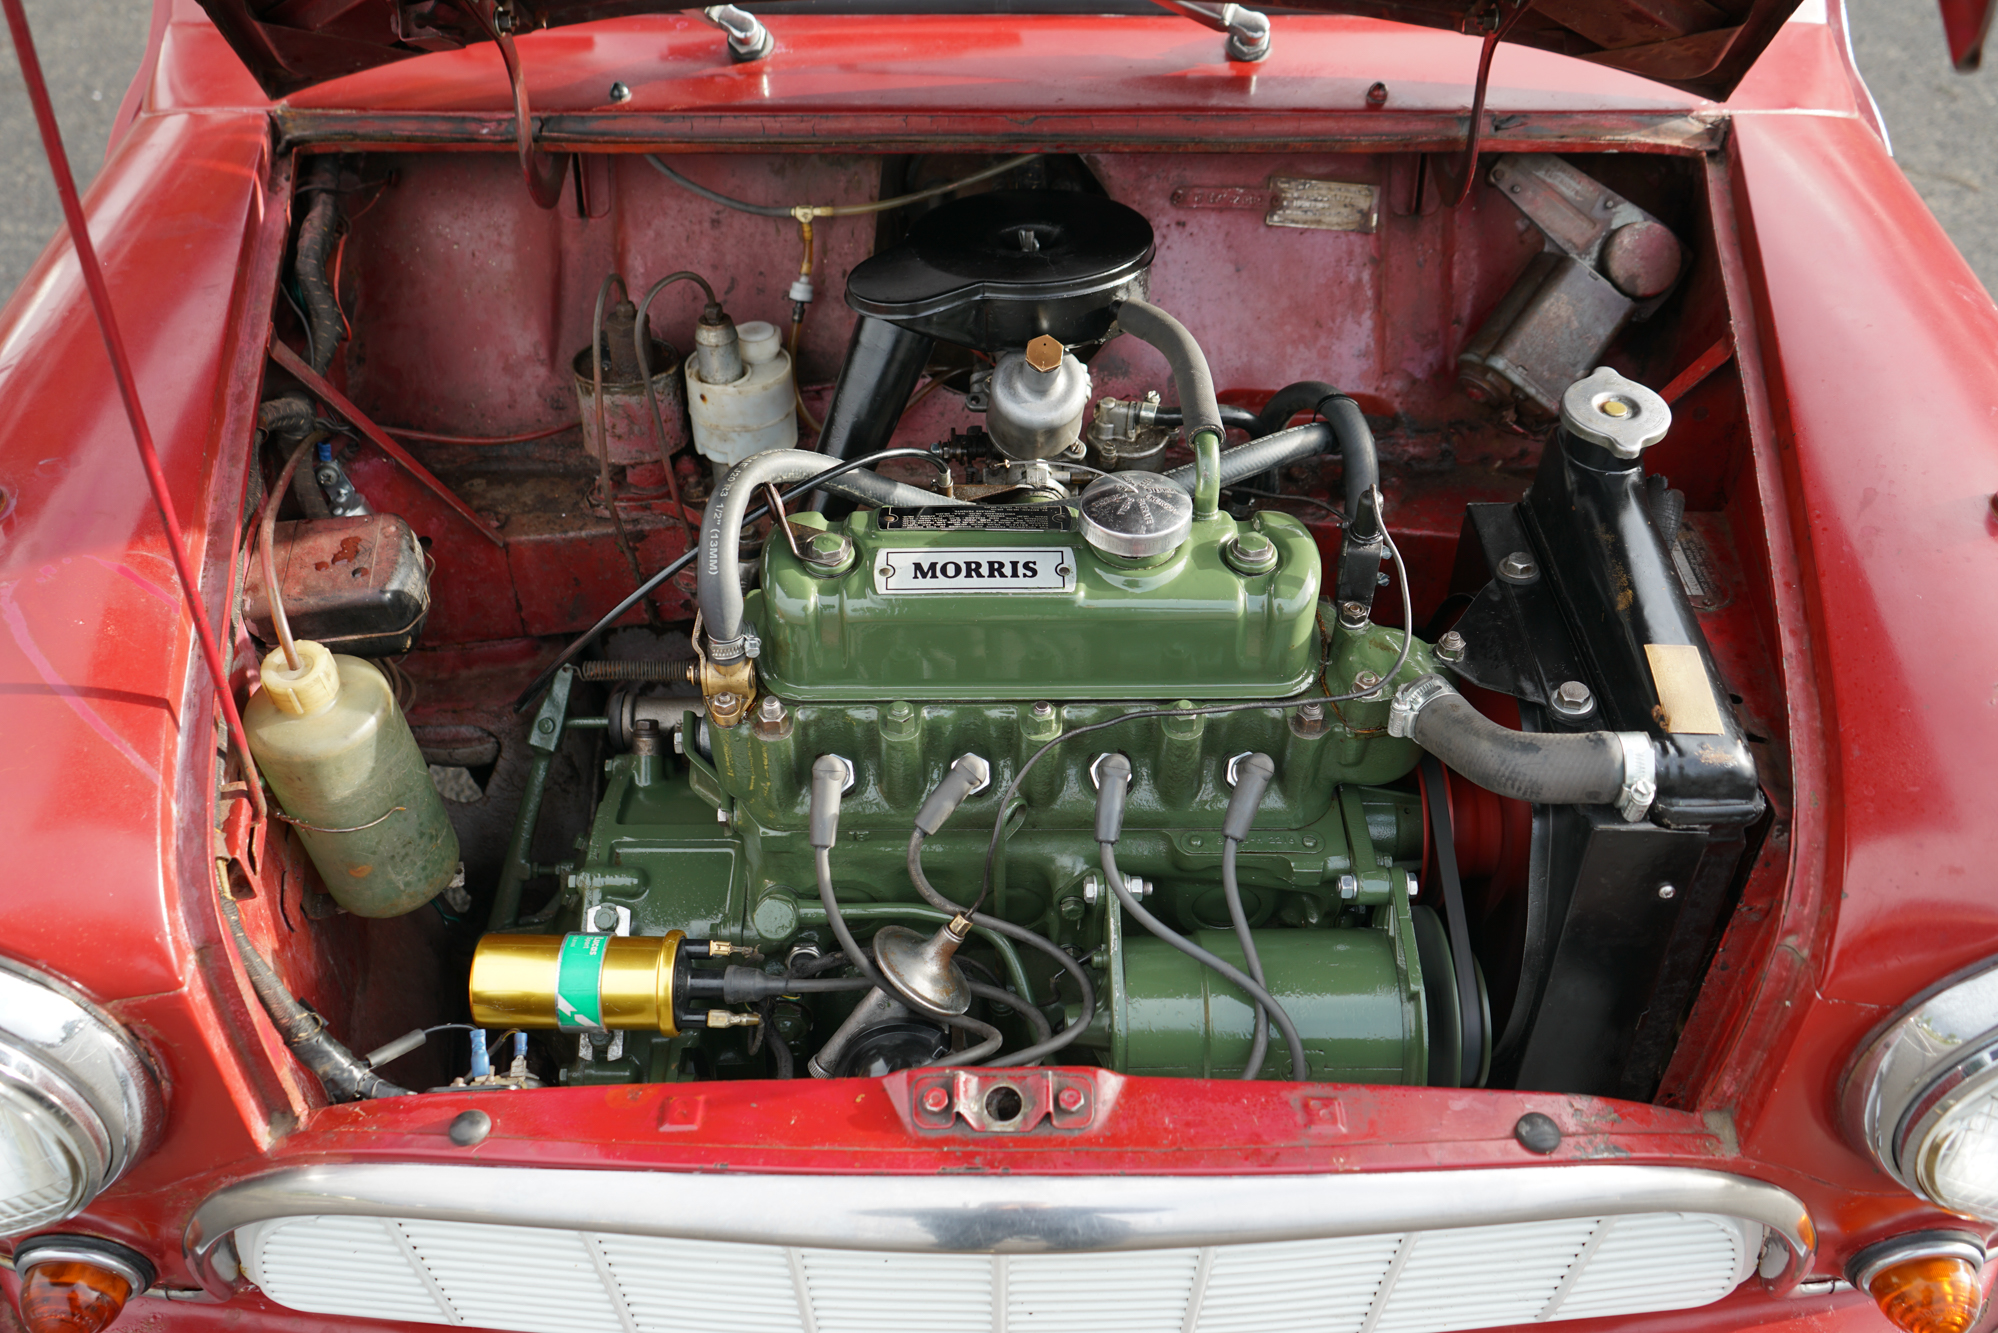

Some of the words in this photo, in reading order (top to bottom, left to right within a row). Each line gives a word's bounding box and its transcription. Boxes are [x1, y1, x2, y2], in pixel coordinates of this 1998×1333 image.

[713, 502, 725, 526] 1/2"
[708, 528, 721, 576] (13MM)
[912, 560, 1038, 580] MORRIS
[589, 936, 604, 956] Lucas
